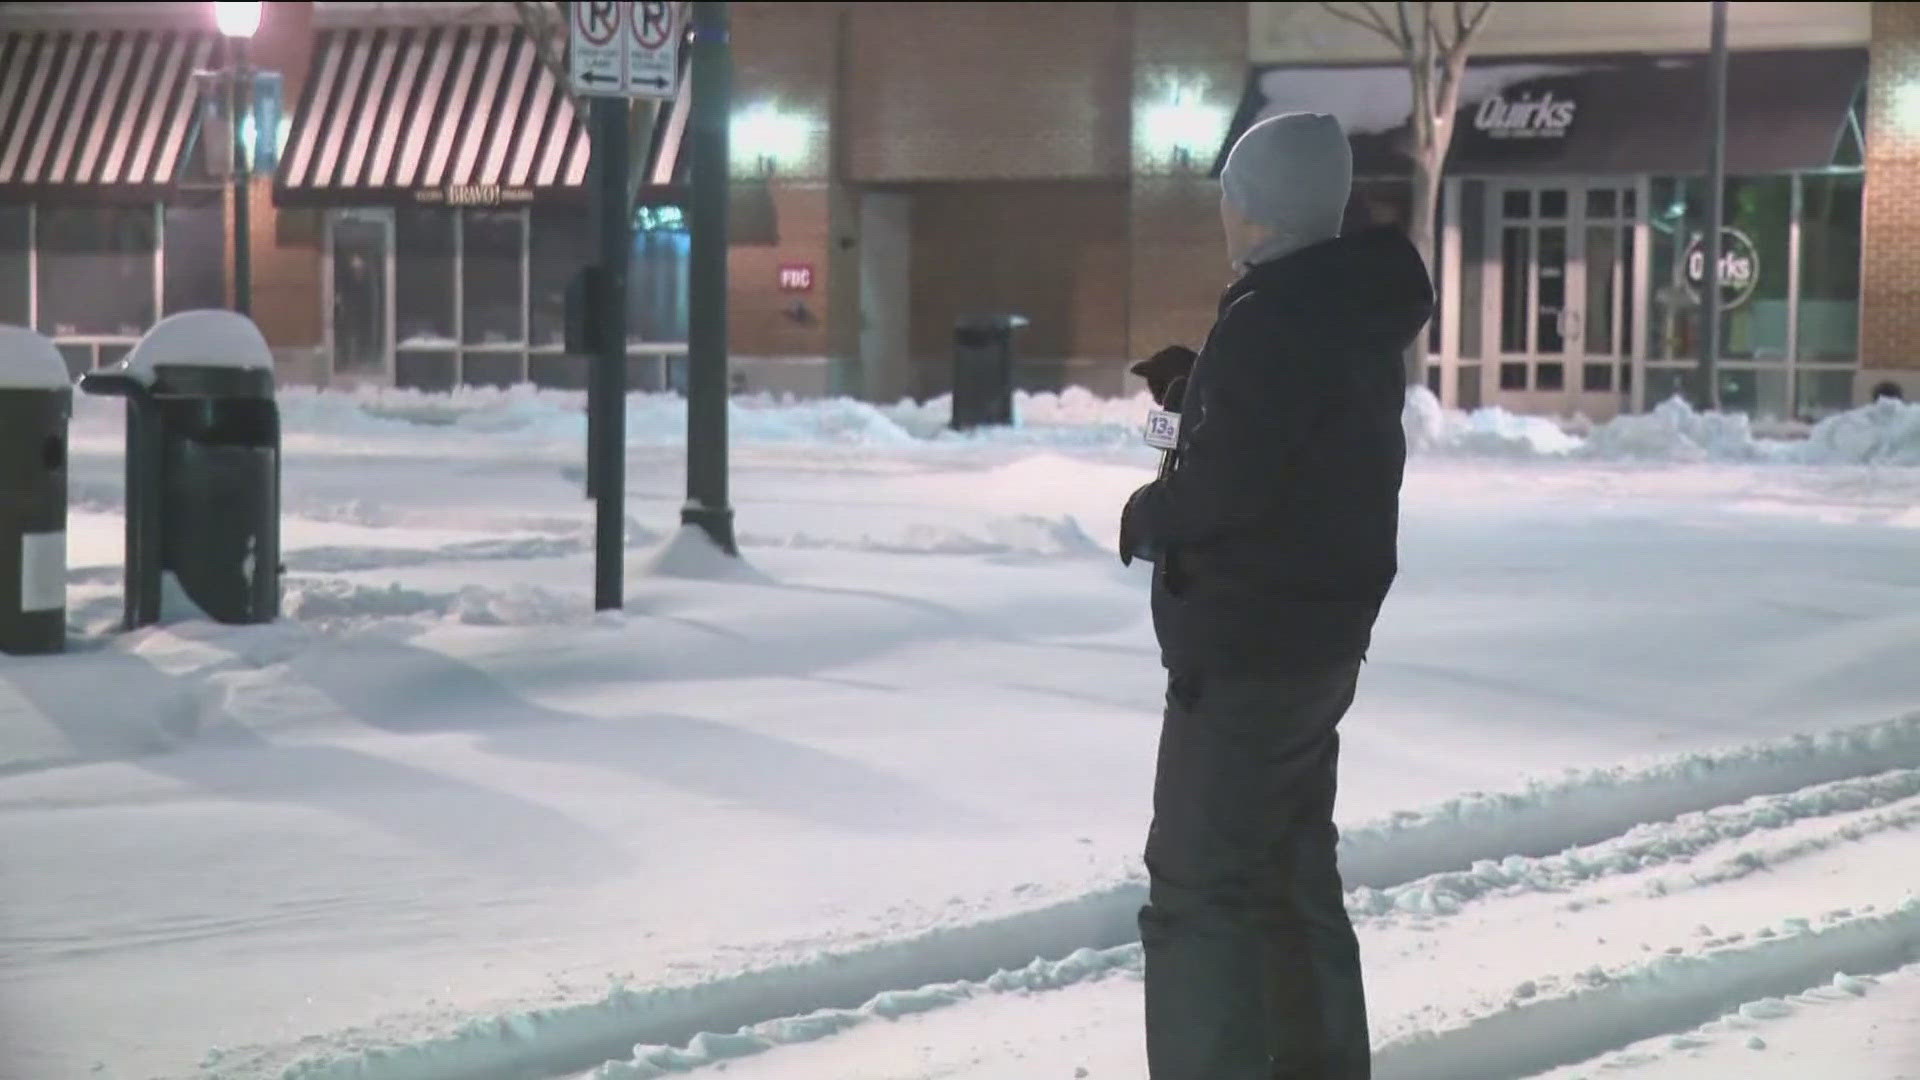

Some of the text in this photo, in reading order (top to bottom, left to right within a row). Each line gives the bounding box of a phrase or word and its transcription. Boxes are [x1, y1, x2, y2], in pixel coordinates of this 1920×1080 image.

[1474, 92, 1576, 130] Quirks
[782, 269, 810, 288] FDC
[1689, 250, 1750, 281] Qrks
